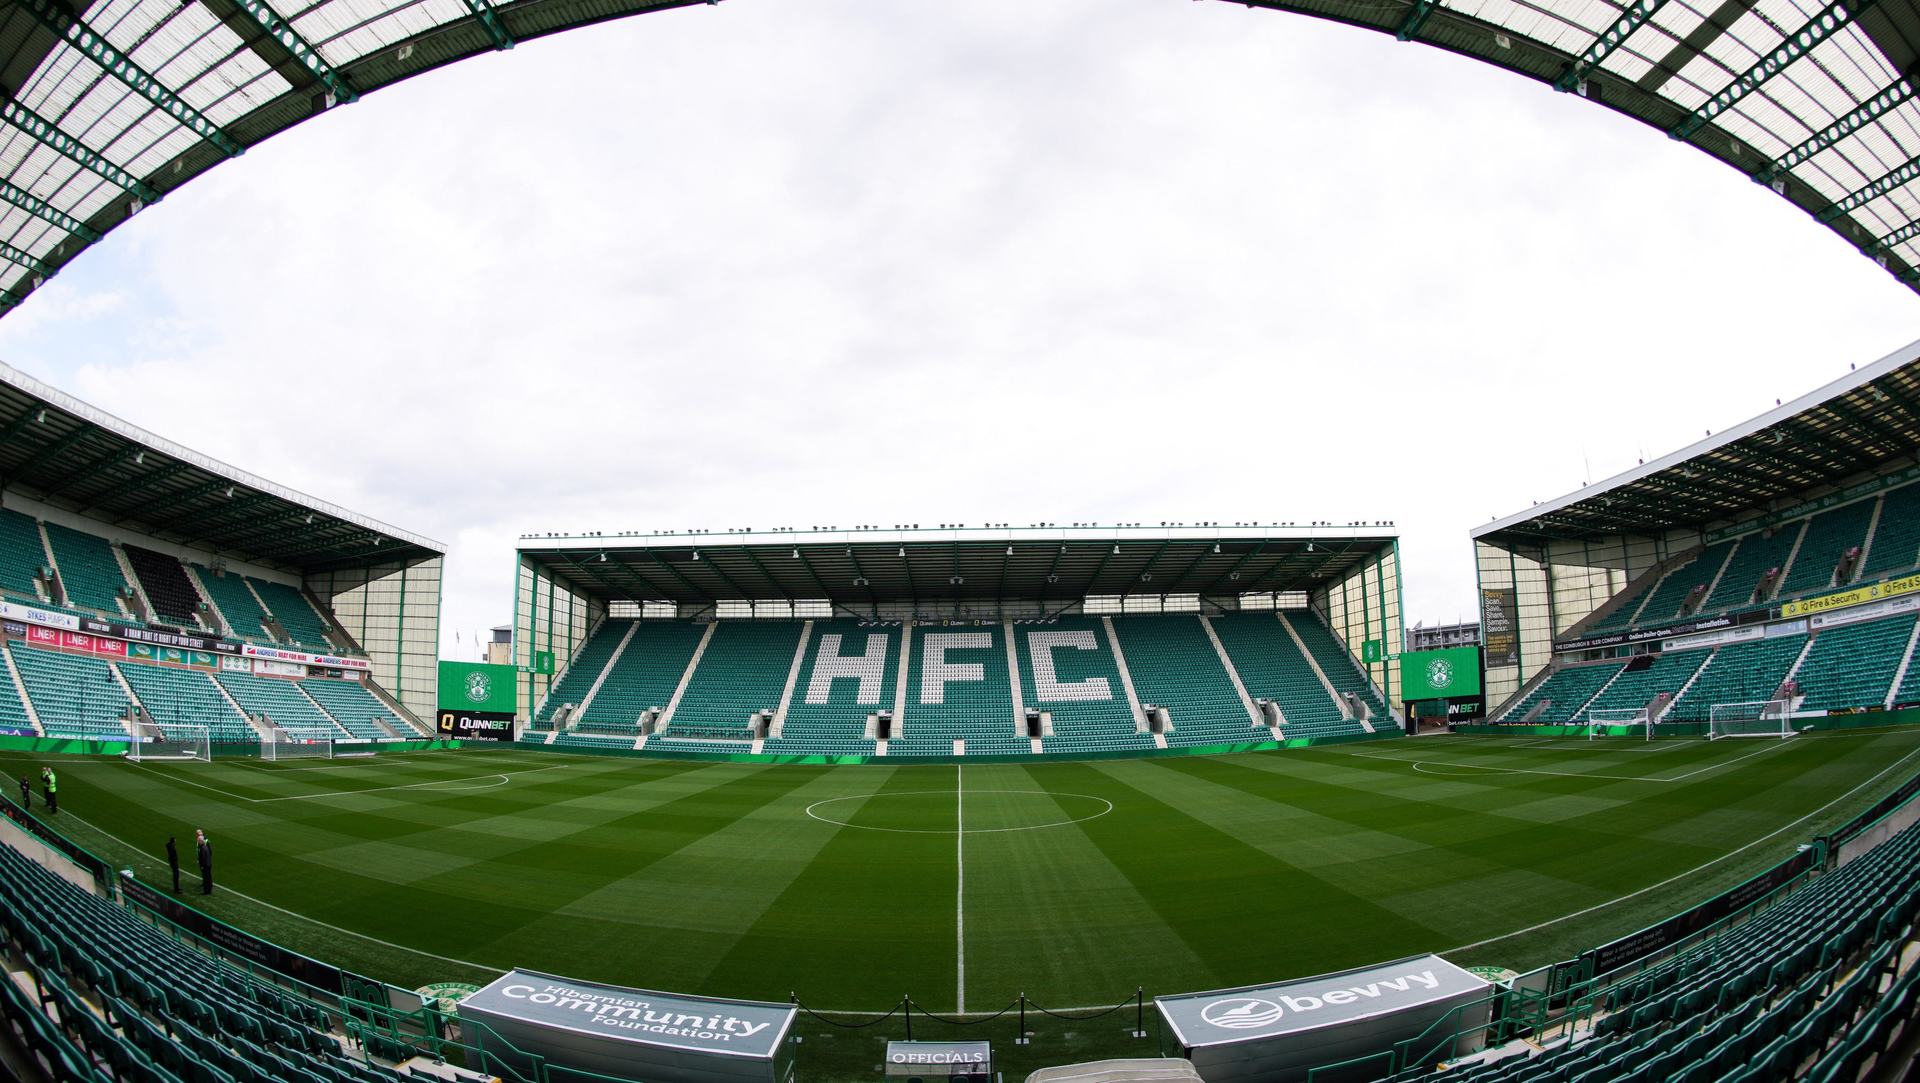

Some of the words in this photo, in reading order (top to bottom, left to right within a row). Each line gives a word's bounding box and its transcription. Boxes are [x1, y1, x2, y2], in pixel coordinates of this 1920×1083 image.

[1892, 581, 1907, 591] Fire
[1908, 579, 1914, 587] &
[1809, 600, 1823, 609] Fire
[1824, 598, 1830, 607] &
[1831, 591, 1860, 606] Security
[27, 609, 47, 622] SYKES
[33, 627, 56, 641] LNER
[142, 630, 153, 640] THAT
[153, 631, 158, 641] IS
[158, 632, 171, 643] RIGHT
[171, 635, 178, 645] UP
[178, 636, 189, 647] YOUR
[189, 638, 204, 649] STREET
[1563, 641, 1587, 649] EDINBURGH
[1601, 635, 1623, 645] COMPANY
[1696, 618, 1730, 630] Installation.
[67, 635, 89, 648] LNER
[100, 641, 122, 652] LNER
[256, 648, 278, 660] ANDREWS
[278, 651, 289, 660] HEAT
[289, 652, 298, 661] FOR
[298, 653, 307, 661] HIRE
[322, 656, 341, 666] ANDREWS
[341, 658, 351, 666] HEAT
[804, 630, 1113, 704] HFC
[460, 717, 511, 730] QUINNBET
[453, 734, 499, 742] www.qubet.com
[1279, 968, 1441, 1012] bevvy
[544, 986, 650, 1009] Hibernian
[502, 985, 770, 1037] Community
[591, 1014, 731, 1041] Foundation
[892, 1052, 984, 1064] OFFICIALS
